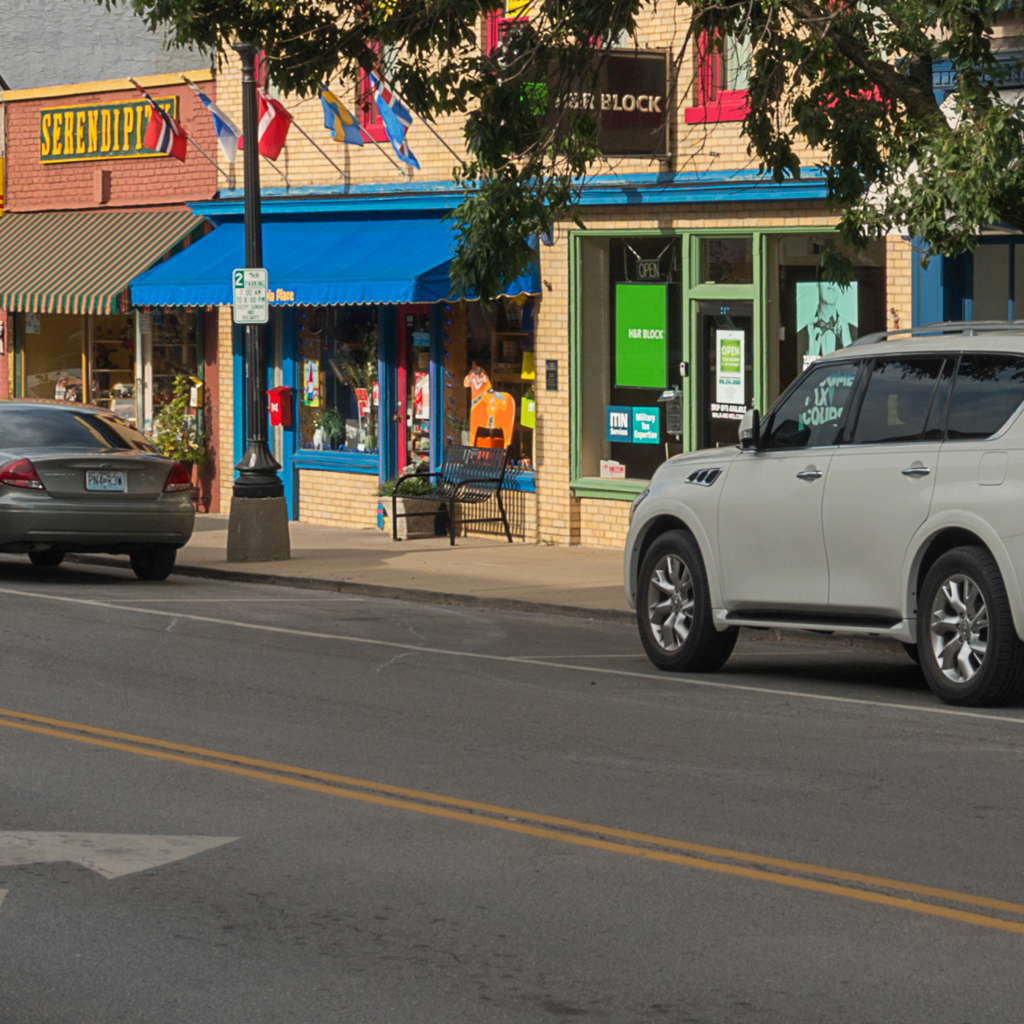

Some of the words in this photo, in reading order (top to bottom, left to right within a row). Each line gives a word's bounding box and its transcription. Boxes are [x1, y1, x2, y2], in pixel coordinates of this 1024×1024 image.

[600, 93, 662, 113] BLOCK
[638, 262, 660, 278] OPEN
[235, 272, 244, 286] 2
[628, 328, 642, 339] H&R
[643, 329, 664, 339] BLOCK
[721, 345, 740, 356] OPEN
[609, 412, 629, 428] ITIN
[635, 413, 656, 424] Military
[641, 422, 650, 430] Tax
[634, 430, 658, 440] Expertise
